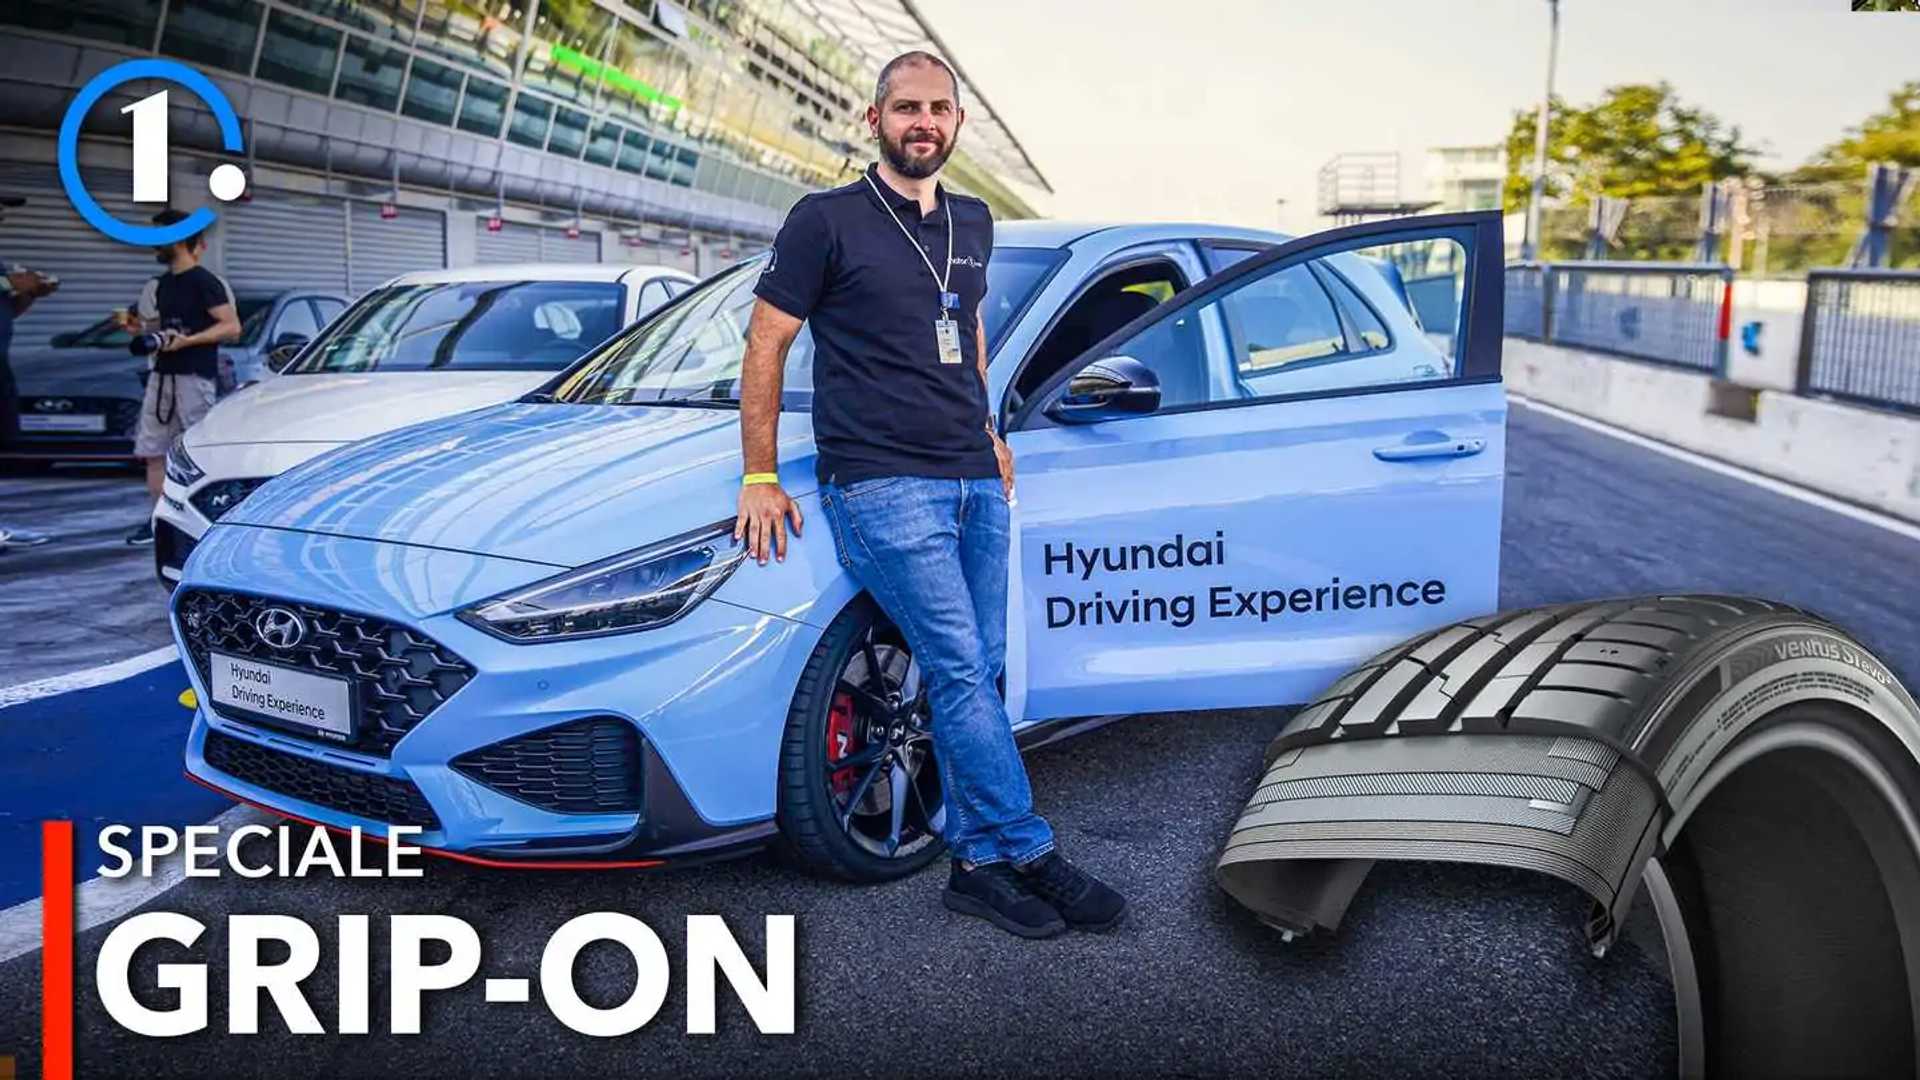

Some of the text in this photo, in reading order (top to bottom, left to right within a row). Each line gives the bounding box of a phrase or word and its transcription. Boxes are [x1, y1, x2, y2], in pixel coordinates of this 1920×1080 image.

[1044, 530, 1225, 581] Hyundai
[1046, 577, 1446, 629] Driving Experience
[230, 663, 272, 685] Hyundai
[232, 684, 326, 721] Driving Experience
